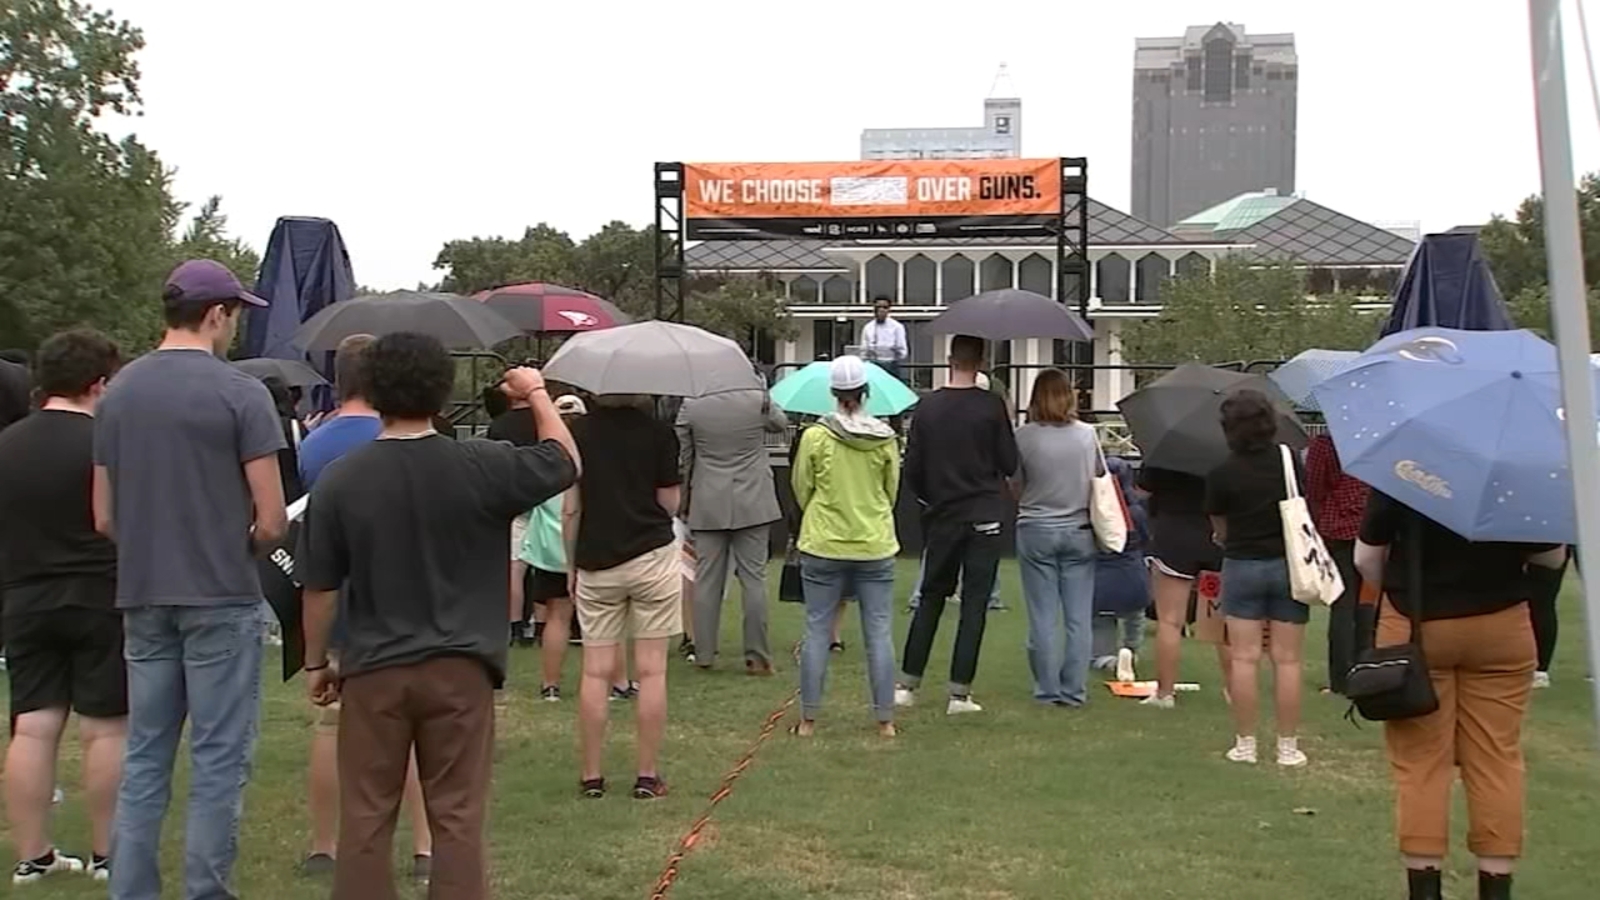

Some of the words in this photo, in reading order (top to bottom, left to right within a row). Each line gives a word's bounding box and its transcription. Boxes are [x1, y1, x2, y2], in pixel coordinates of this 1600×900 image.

[699, 179, 735, 203] WE
[741, 179, 822, 204] CHOOSE
[917, 176, 971, 201] OVER
[978, 175, 1042, 199] GUNS.
